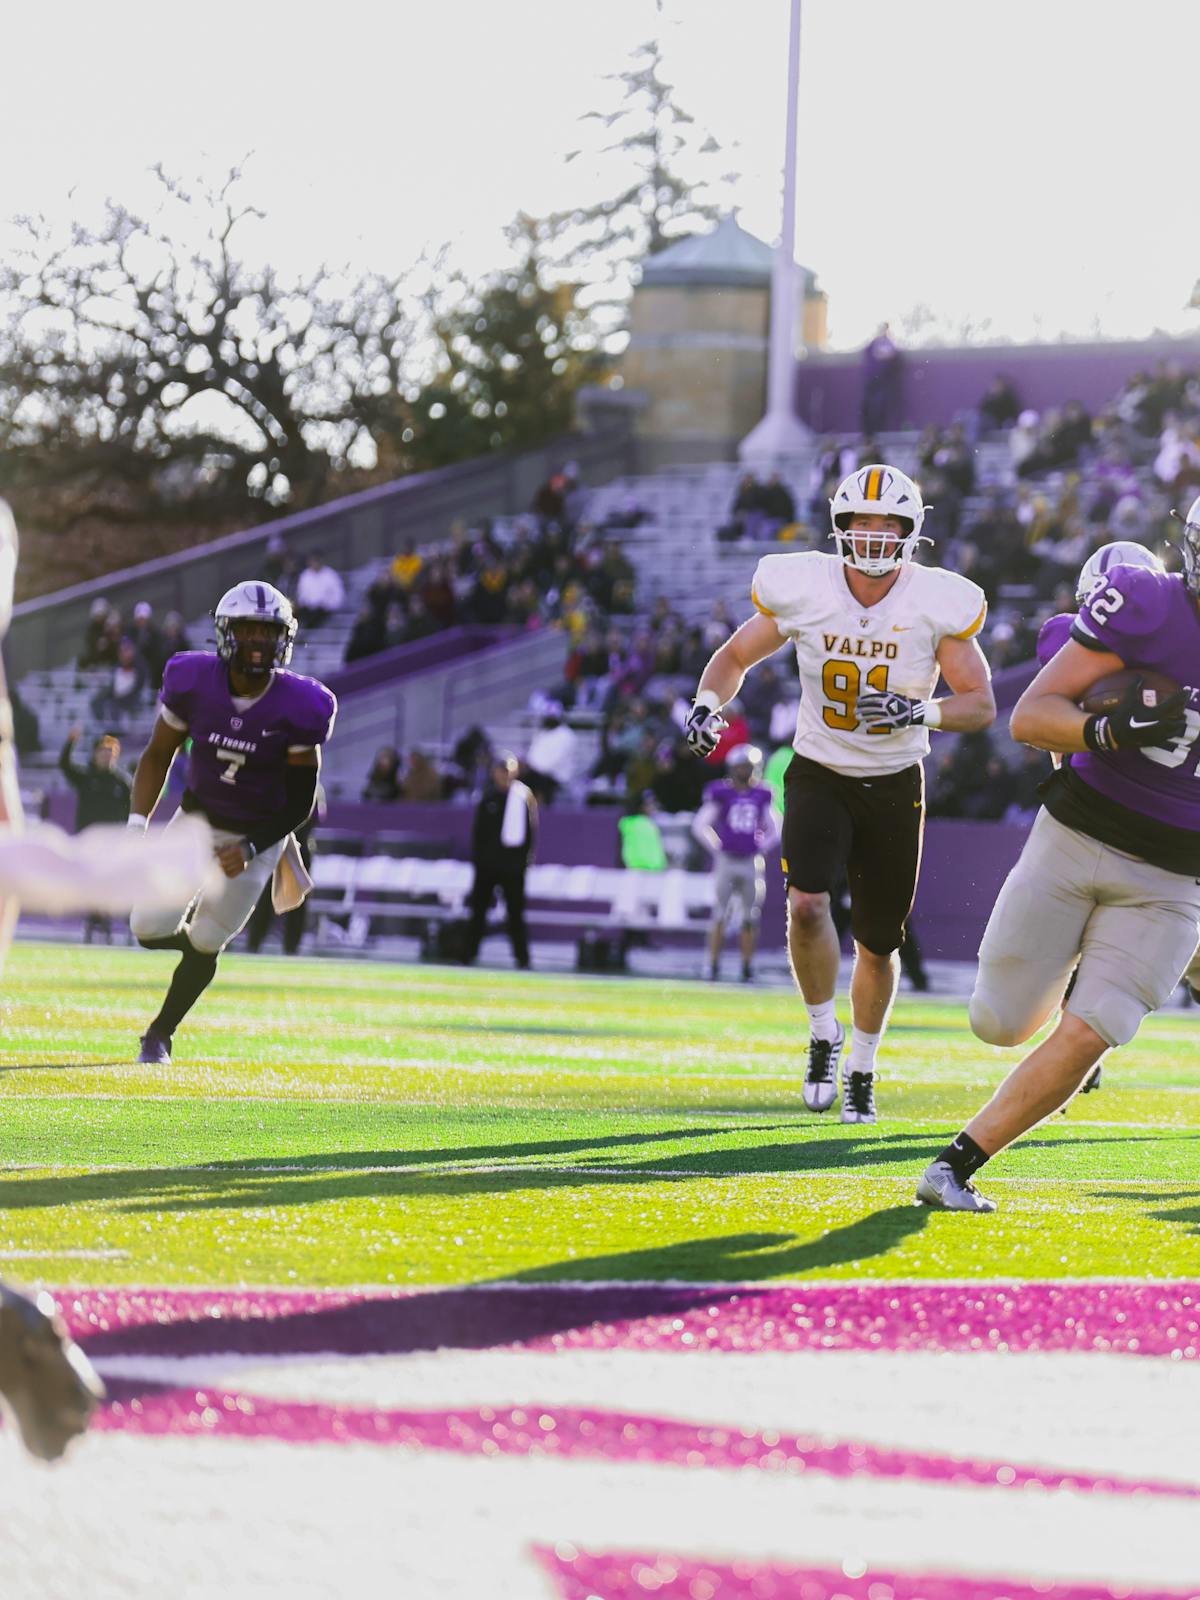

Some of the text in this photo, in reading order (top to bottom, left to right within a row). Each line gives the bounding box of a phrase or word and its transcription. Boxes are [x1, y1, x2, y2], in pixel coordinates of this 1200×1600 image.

[823, 634, 898, 660] VALPO
[822, 658, 892, 735] 91
[222, 737, 257, 752] THOMAS
[216, 748, 246, 785] 7
